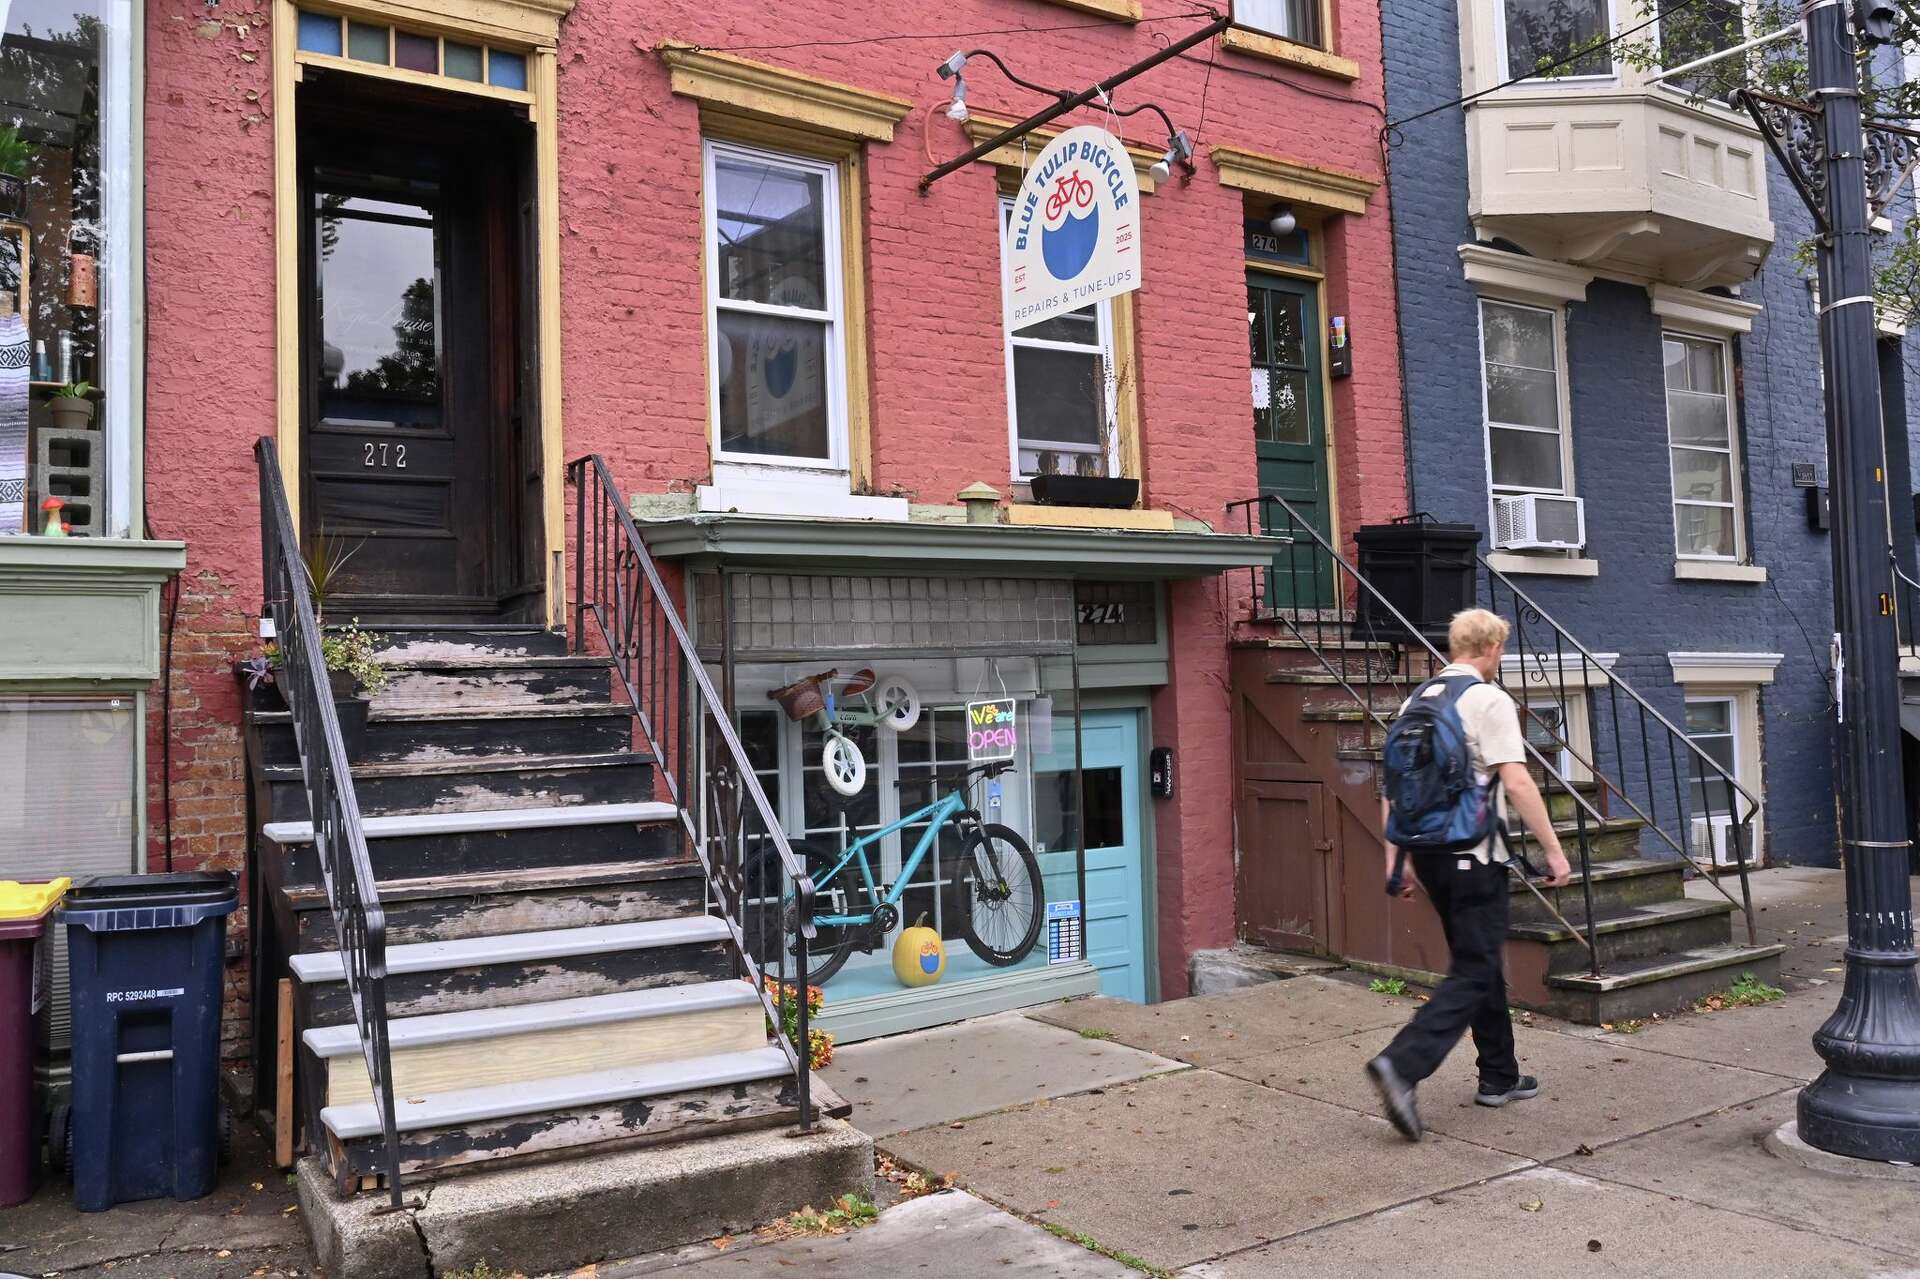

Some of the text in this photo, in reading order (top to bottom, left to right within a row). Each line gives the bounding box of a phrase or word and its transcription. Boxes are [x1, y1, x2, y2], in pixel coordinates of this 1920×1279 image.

[1016, 141, 1129, 250] BLUE TULIP BICYCLE
[1116, 232, 1132, 244] 2025
[1253, 236, 1277, 251] 274
[1015, 273, 1026, 284] EST
[1015, 269, 1132, 320] REPAIRS & TUNE-UPS
[364, 442, 406, 467] 272
[970, 705, 1014, 725] We are
[969, 728, 1017, 750] OPEN
[106, 992, 124, 1002] RPC
[125, 989, 157, 1001] 5292448
